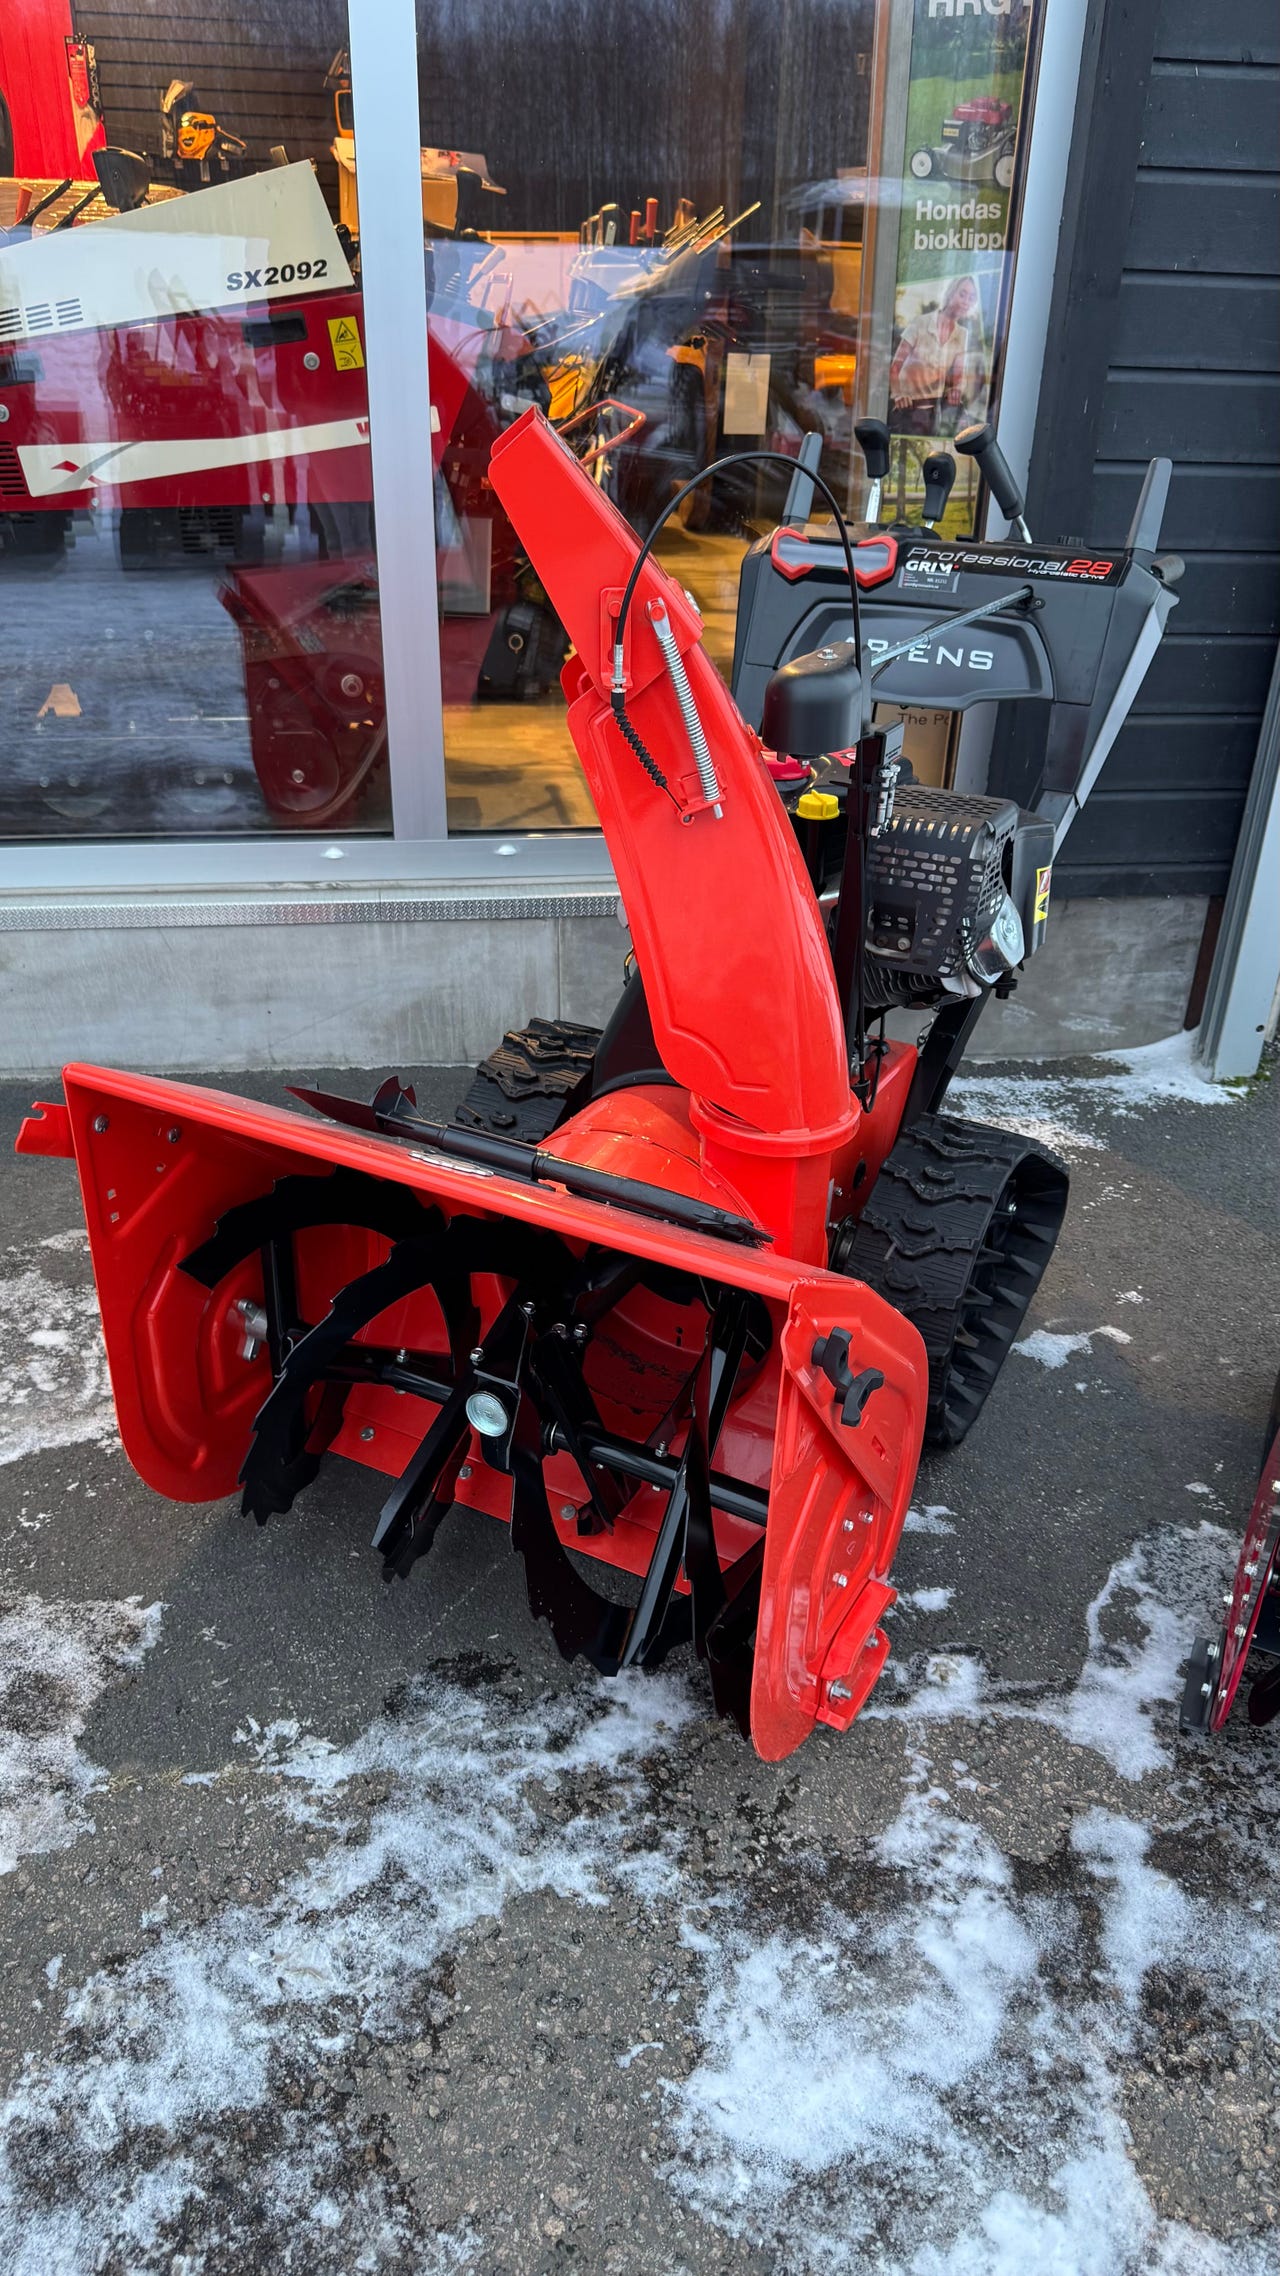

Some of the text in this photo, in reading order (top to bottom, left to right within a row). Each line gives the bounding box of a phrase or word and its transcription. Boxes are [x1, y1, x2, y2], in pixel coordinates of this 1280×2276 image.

[916, 199, 1001, 220] Hondas
[227, 259, 328, 291] SX2092
[907, 547, 1113, 575] Professional 28
[1027, 568, 1105, 580] Hydrostatic Drive
[897, 713, 928, 725] The
